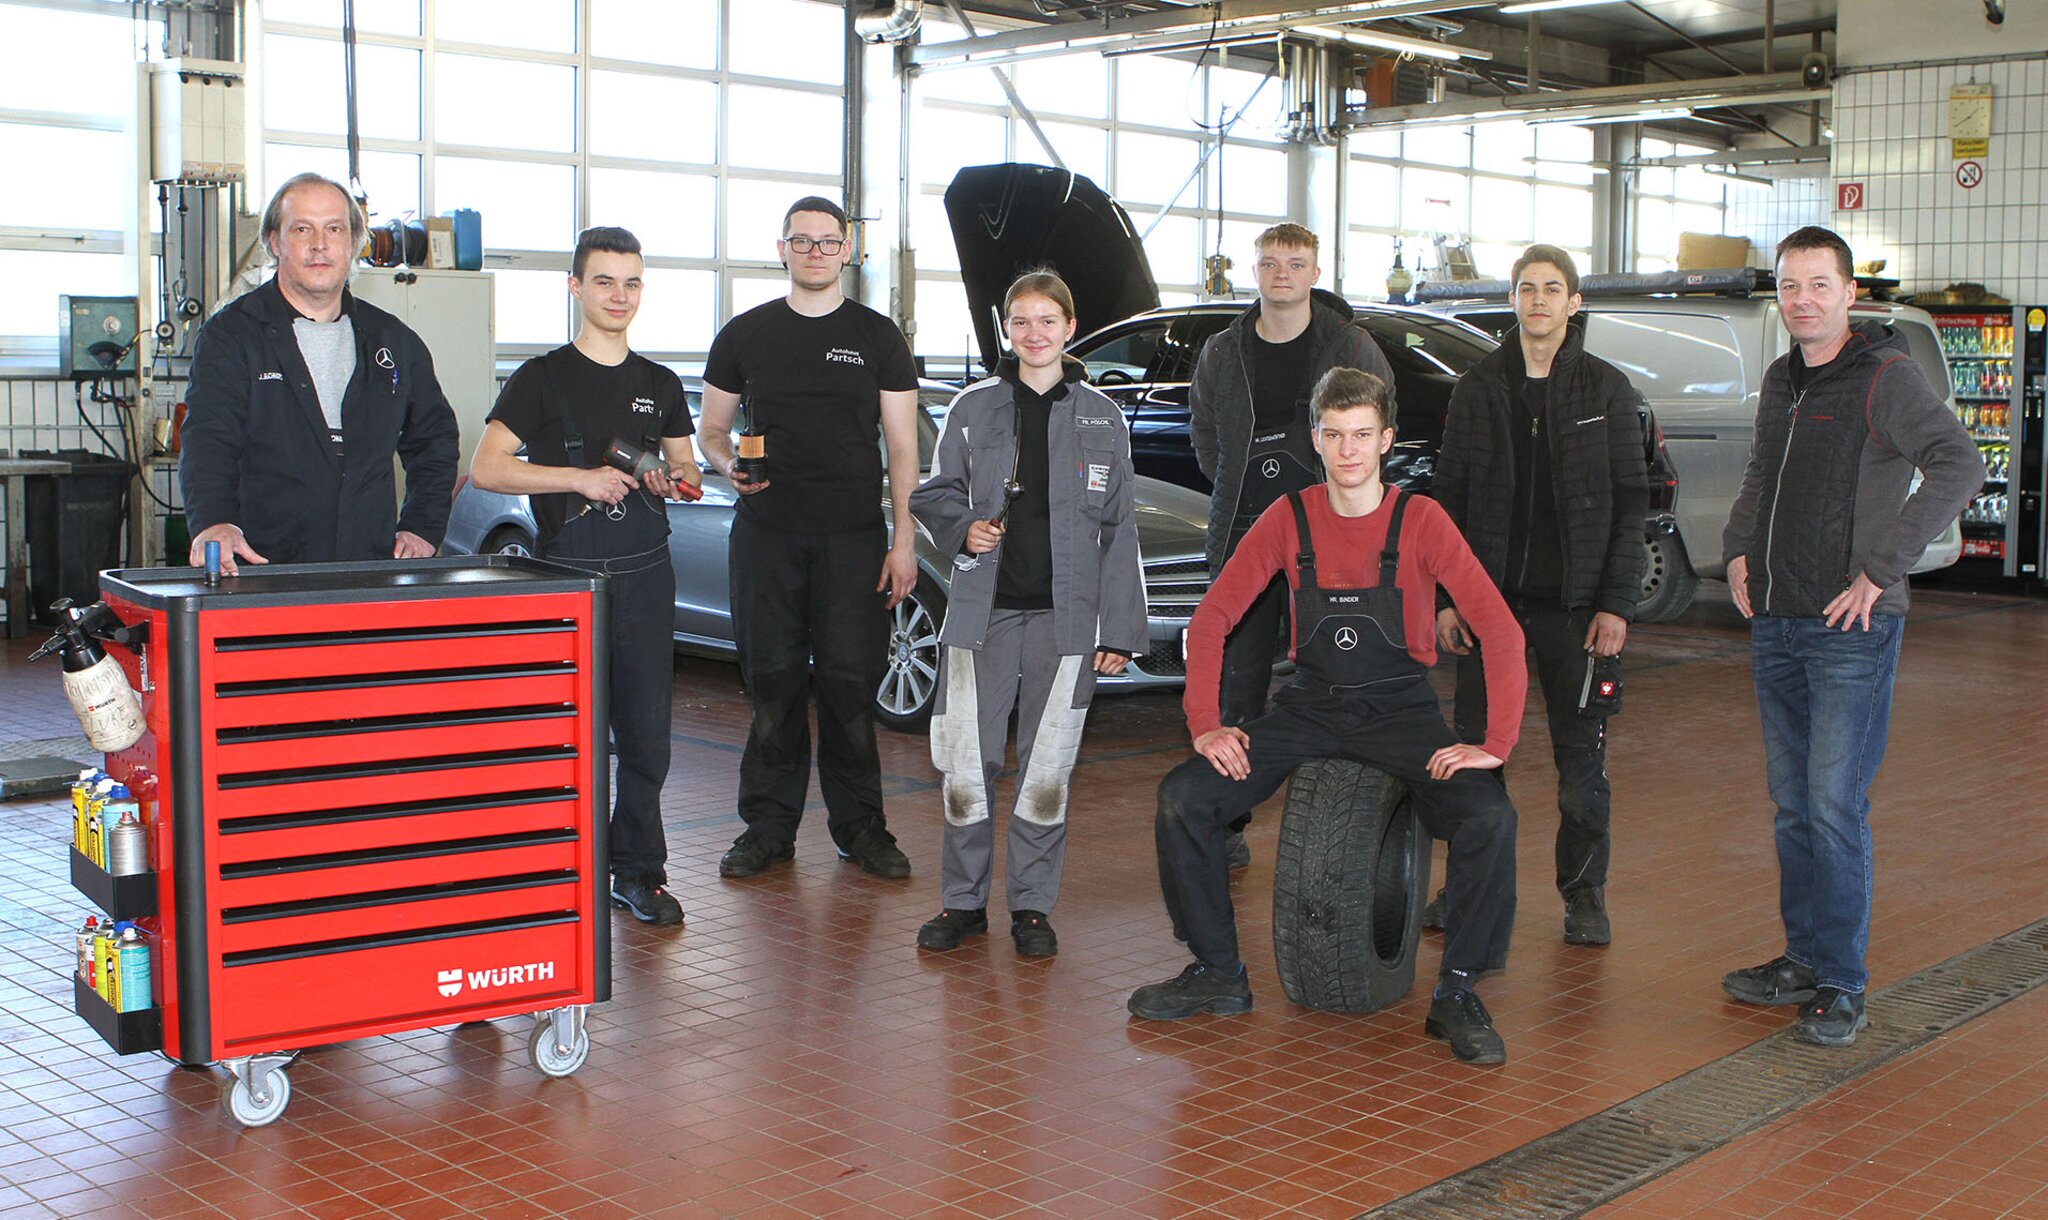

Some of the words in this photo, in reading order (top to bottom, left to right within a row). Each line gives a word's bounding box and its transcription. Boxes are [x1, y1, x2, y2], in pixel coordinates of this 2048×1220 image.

[831, 347, 860, 356] Autohaus
[826, 352, 865, 366] Partsch
[467, 961, 554, 990] WÜRTH
